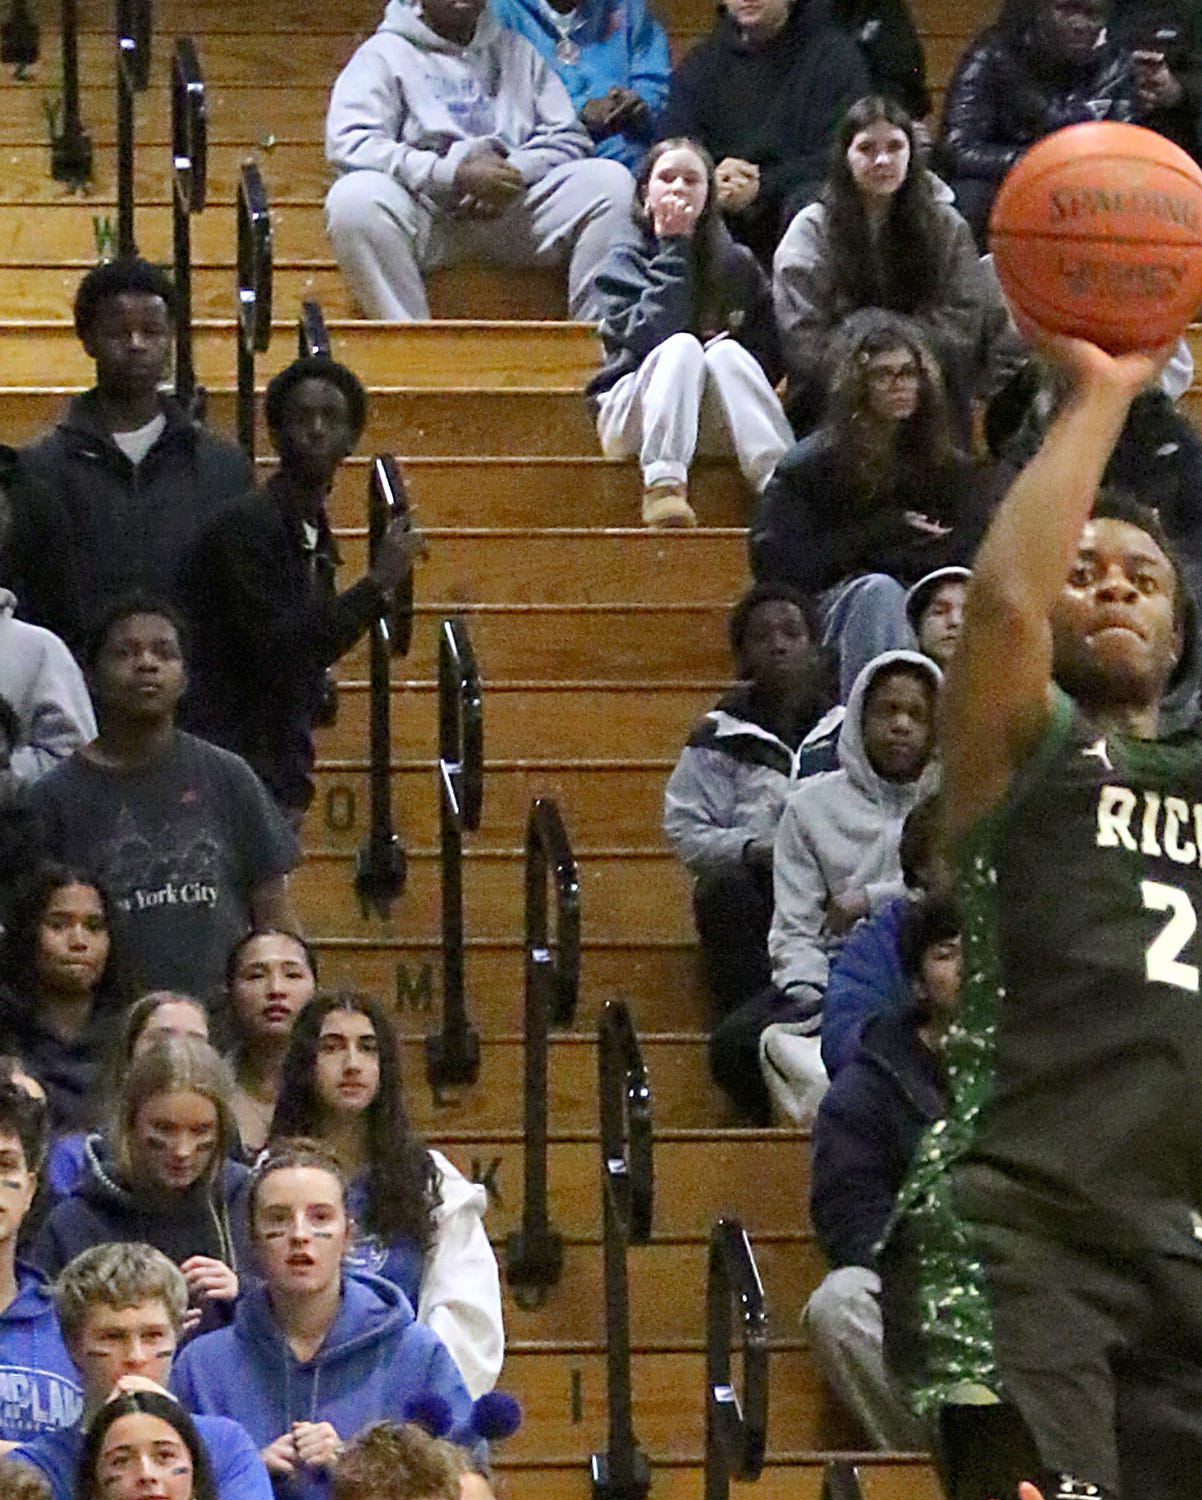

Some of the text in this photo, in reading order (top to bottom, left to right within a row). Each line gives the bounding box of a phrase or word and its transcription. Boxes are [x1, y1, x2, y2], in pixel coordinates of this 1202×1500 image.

[180, 881, 219, 908] City
[1140, 879, 1200, 992] 2
[396, 962, 433, 1012] M
